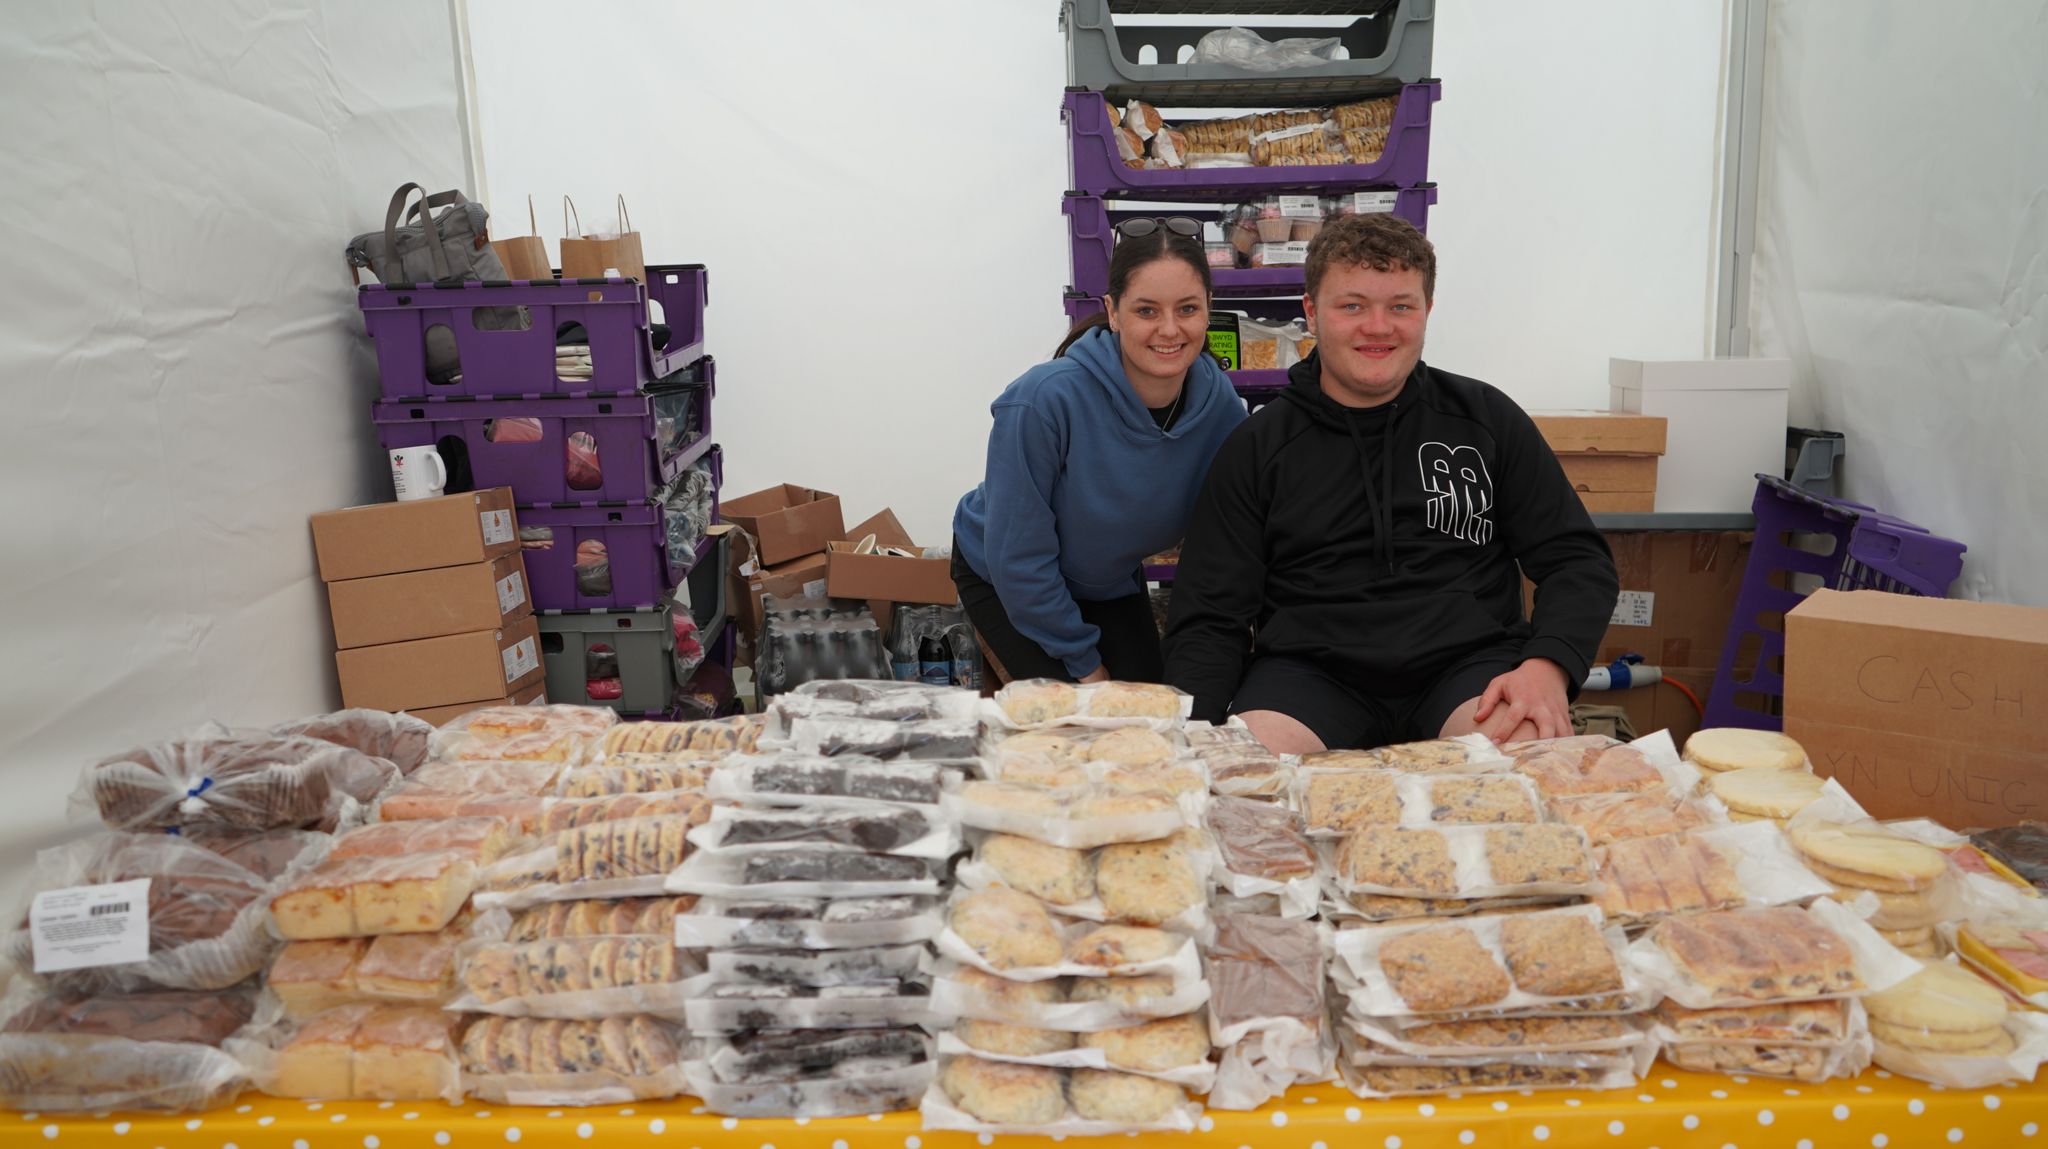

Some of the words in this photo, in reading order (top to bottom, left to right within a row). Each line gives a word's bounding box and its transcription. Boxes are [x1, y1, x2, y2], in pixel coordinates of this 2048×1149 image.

[1857, 655, 2023, 717] CASH
[1826, 752, 1878, 790] YN
[1909, 768, 2037, 814] UNIG
